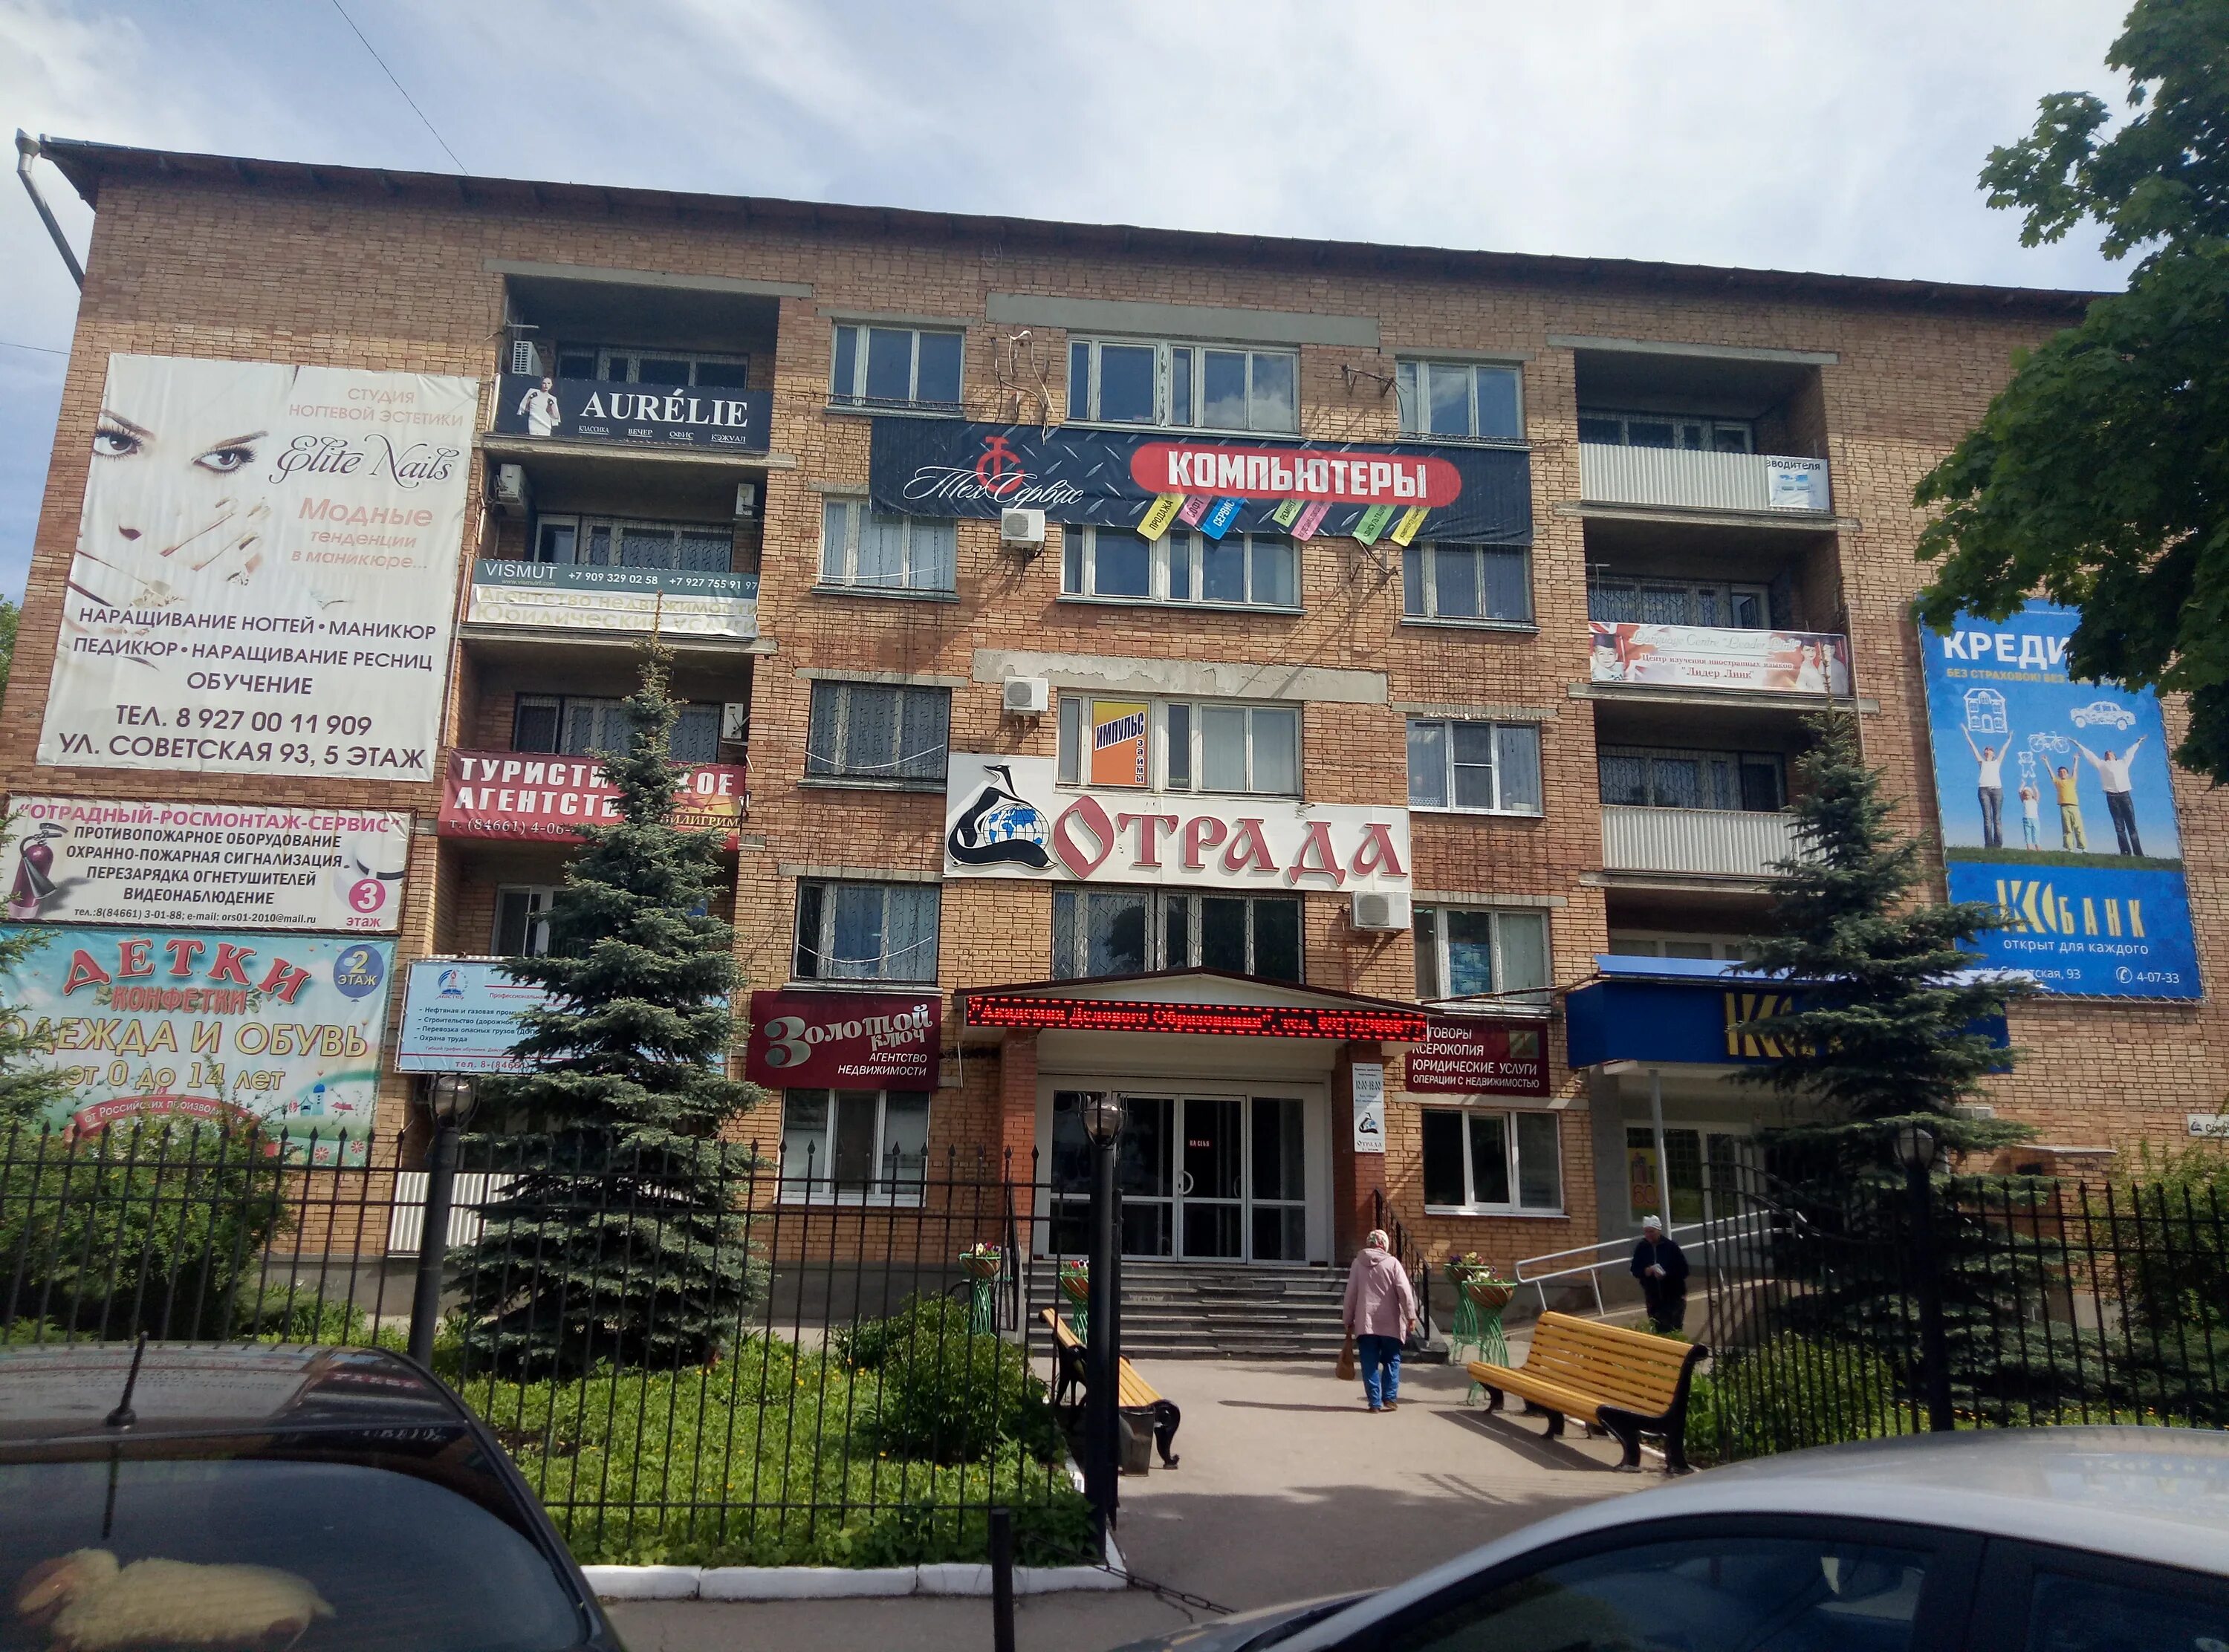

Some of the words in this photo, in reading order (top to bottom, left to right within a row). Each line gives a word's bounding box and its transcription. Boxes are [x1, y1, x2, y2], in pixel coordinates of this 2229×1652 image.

[347, 387, 415, 404] СТУДИЯ
[288, 402, 374, 422] НОГТЕВОЙ
[378, 409, 464, 427] ЭСТЕТИКИ
[580, 388, 749, 428] AURÉLIE
[578, 425, 609, 435] КЛАССИКА
[628, 428, 652, 437] ВЕЧЕР
[669, 430, 695, 439] ОФИС
[268, 435, 364, 484] Elite
[364, 433, 460, 489] Nails
[1167, 450, 1427, 498] КОМПЬЮТЕРЫ
[297, 496, 434, 527] Модные
[1149, 499, 1173, 530] ПРОДАЖА
[1186, 498, 1204, 518] СОФТ
[1213, 499, 1235, 527] СЕРВИС
[1280, 501, 1297, 521] РЕМОНТ
[310, 530, 418, 549] тенденции
[291, 550, 301, 562] в
[305, 551, 429, 570] маникюре...
[485, 562, 557, 579] VISMUT
[568, 572, 582, 581] +7
[585, 572, 603, 582] 909
[607, 573, 626, 583] 329
[629, 574, 642, 584] 02
[645, 576, 658, 585] 58
[669, 577, 683, 586] +7
[686, 578, 705, 587] 927
[707, 579, 727, 589] 755
[730, 580, 741, 589] 91
[745, 582, 758, 591] 97
[480, 587, 591, 608] Агентство
[599, 596, 758, 616] недвижимости
[78, 606, 237, 631] НАРАЩИВАНИЕ
[241, 614, 315, 634] НОГТЕЙ
[328, 620, 436, 640] МАНИКЮР
[475, 603, 663, 629] Юридические
[1687, 634, 1720, 647] Centre
[1943, 631, 2071, 671] КРЕДИ
[73, 636, 178, 657] ПЕДИКЮР
[190, 644, 348, 667] НАРАЩИВАНИЕ
[352, 652, 433, 672] РЕСНИЦ
[1642, 654, 1667, 665] Центр
[1670, 657, 1707, 666] изучения
[1709, 659, 1761, 668] иностранных
[1681, 666, 1720, 678] "Лидер
[1724, 669, 1754, 679] Линк"
[1947, 668, 1967, 678] БЕЗ
[1970, 670, 2041, 682] СТРАХОВОК!
[2045, 674, 2065, 683] БЕЗ
[186, 671, 314, 697] ОБУЧЕНИЕ
[116, 704, 167, 728] ТЕЛ.
[176, 707, 190, 727] 8
[201, 709, 244, 732] 927
[251, 712, 282, 733] 00
[293, 714, 318, 734] 11
[325, 715, 373, 737] 909
[1095, 712, 1145, 750] ИМПУЛЬС
[59, 732, 100, 756] УЛ.
[108, 735, 272, 763] СОВЕТСКАЯ
[280, 744, 316, 767] 93,
[325, 746, 339, 766] 5
[347, 746, 425, 771] ЭТАЖ
[1135, 738, 1145, 784] займы
[460, 757, 734, 797] ТУРИСТИКОЕ
[453, 787, 620, 818] АГЕНТСТВ
[74, 825, 223, 845] ПРОТИВОПОЖАРНОЕ
[226, 831, 341, 848] ОБОРУДОВАНИЕ
[450, 819, 461, 828] т.
[467, 819, 525, 835] (84661)
[1053, 795, 1408, 886] ОТРАДА
[66, 845, 221, 865] ОХРАННО-ПОЖАРНАЯ
[224, 851, 343, 869] СИГНАЛИЗАЦИЯ
[86, 865, 189, 882] ПЕРЕЗАРЯДКА
[192, 867, 317, 887] ОГНЕТУШИТЕЛЕЙ
[123, 888, 275, 905] ВИДЕОНАБЛЮДЕНИЕ
[359, 882, 377, 910] 3
[145, 911, 185, 921] 3-01-88;
[187, 912, 219, 923] e-mail:
[222, 914, 317, 924] ors01-2010@mail.ru
[345, 916, 380, 928] этаж
[2004, 940, 2054, 953] открыт
[2059, 942, 2084, 954] для
[2089, 943, 2149, 956] каждого
[63, 938, 312, 1005] ДЕТКИ
[351, 950, 369, 975] 2
[338, 974, 377, 986] ЭТАЖ
[2066, 968, 2080, 980] 93
[2137, 973, 2179, 983] 4-07-33
[111, 986, 248, 1015] КОНФЕТКИ
[424, 1007, 459, 1015] Нефтяная
[424, 1016, 474, 1026] Строительство
[476, 1018, 513, 1027] (дорожное
[1068, 1007, 1148, 1024] Делового
[0, 1015, 178, 1056] ОДЕЖДА
[192, 1021, 223, 1054] И
[234, 1022, 369, 1058] ОБУВЬ
[422, 1026, 459, 1034] Перевозка
[765, 1004, 933, 1069] Золотой
[870, 1028, 925, 1051] ключ
[1430, 1027, 1472, 1040] ГОВОРЫ
[869, 1053, 927, 1063] АГЕНТСТВО
[1412, 1058, 1495, 1075] ЮРИДИЧЕСКИЕ
[1499, 1062, 1537, 1076] УСЛУГИ
[64, 1065, 99, 1087] от
[107, 1060, 129, 1087] 0
[135, 1064, 177, 1091] до
[187, 1061, 226, 1089] 14
[234, 1068, 286, 1091] лет
[837, 1064, 927, 1076] НЕДВИЖИМОСТИ
[1413, 1074, 1456, 1085] ОПЕРАЦИИ
[1458, 1076, 1464, 1085] С
[1465, 1077, 1539, 1089] НЕДВИЖИМОСТЬЮ
[85, 1112, 96, 1123] от
